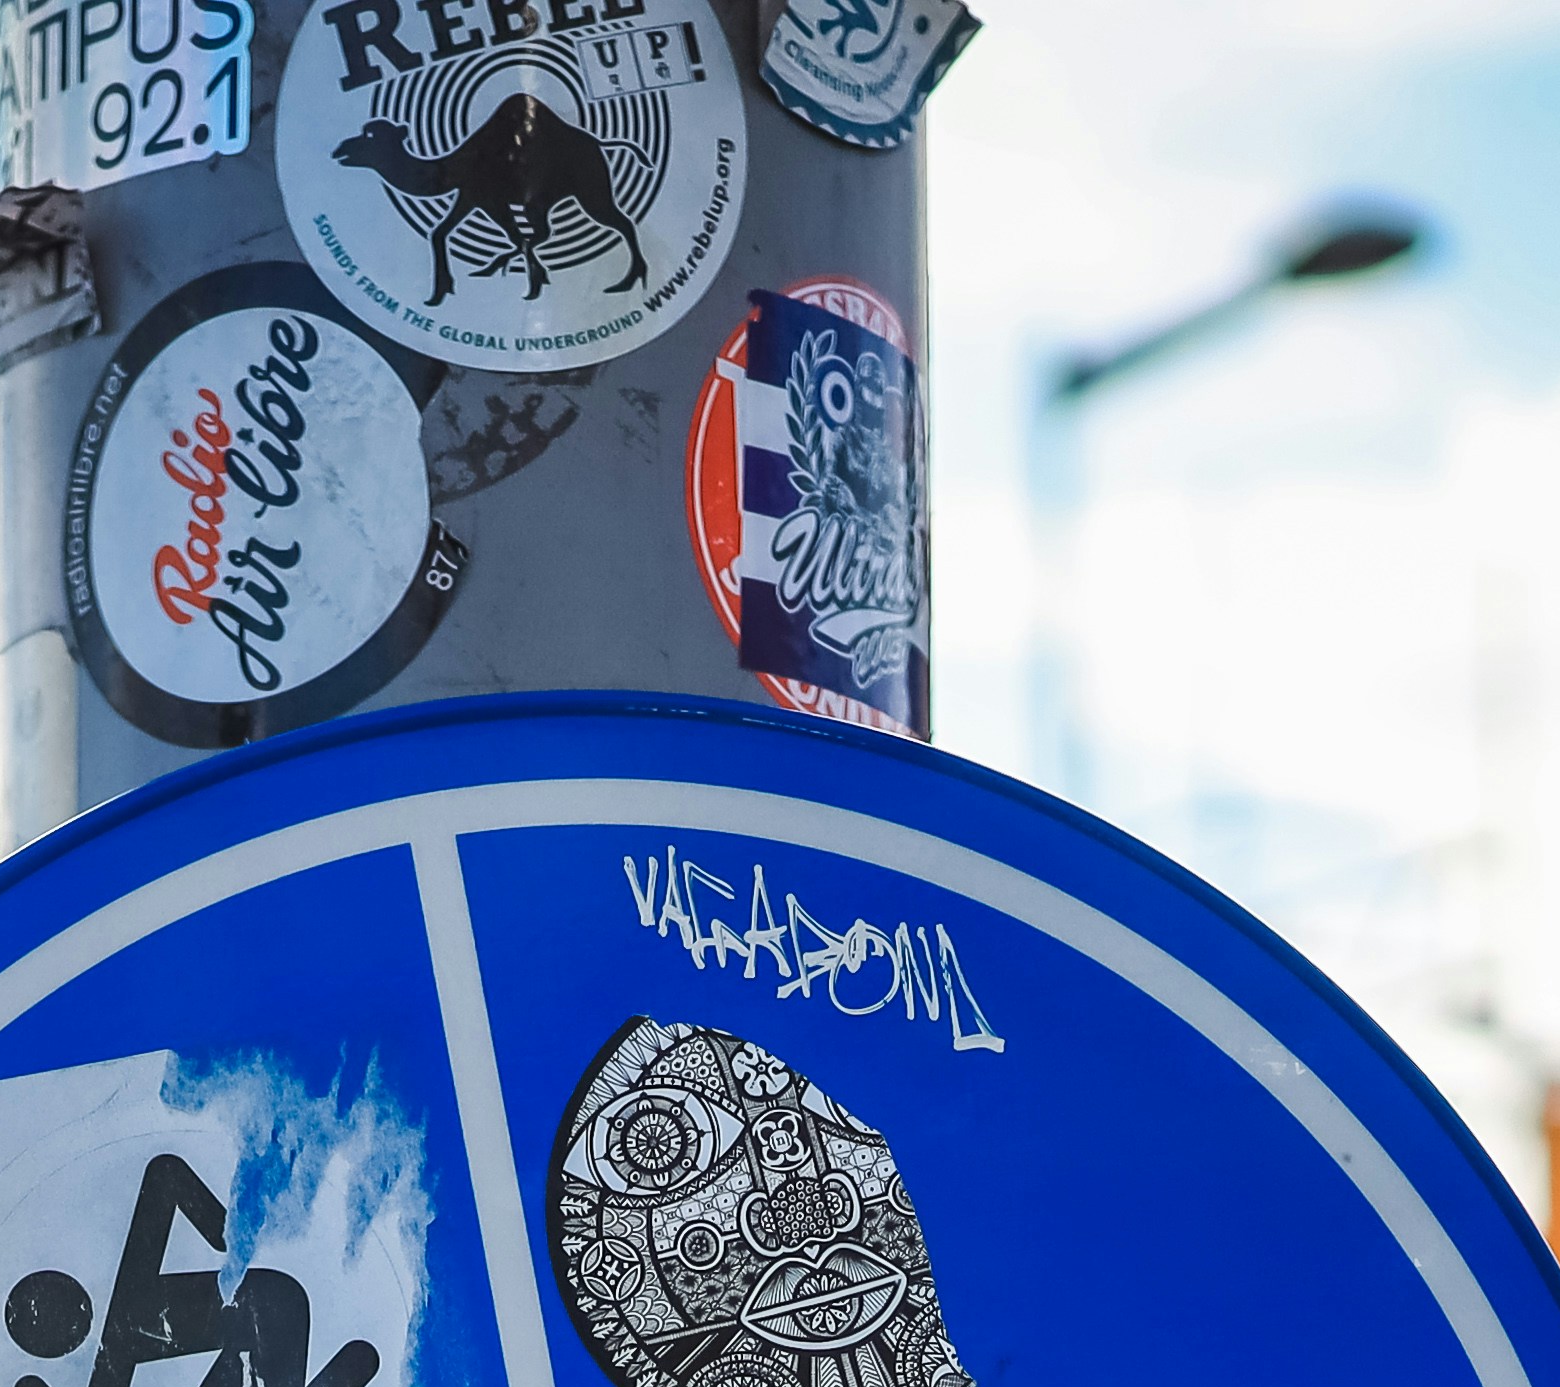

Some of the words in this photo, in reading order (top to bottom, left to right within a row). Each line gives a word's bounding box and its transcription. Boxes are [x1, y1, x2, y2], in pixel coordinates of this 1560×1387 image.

[93, 56, 240, 171] 92.1
[313, 213, 359, 277] SOUNDS
[355, 275, 400, 314] FROM
[402, 307, 436, 332] THE
[439, 325, 508, 351] GLOBAL
[515, 310, 644, 352] UNDERGROUND
[643, 138, 736, 313] www.rebelup.org
[154, 387, 232, 625] Radio
[210, 536, 302, 692] Air
